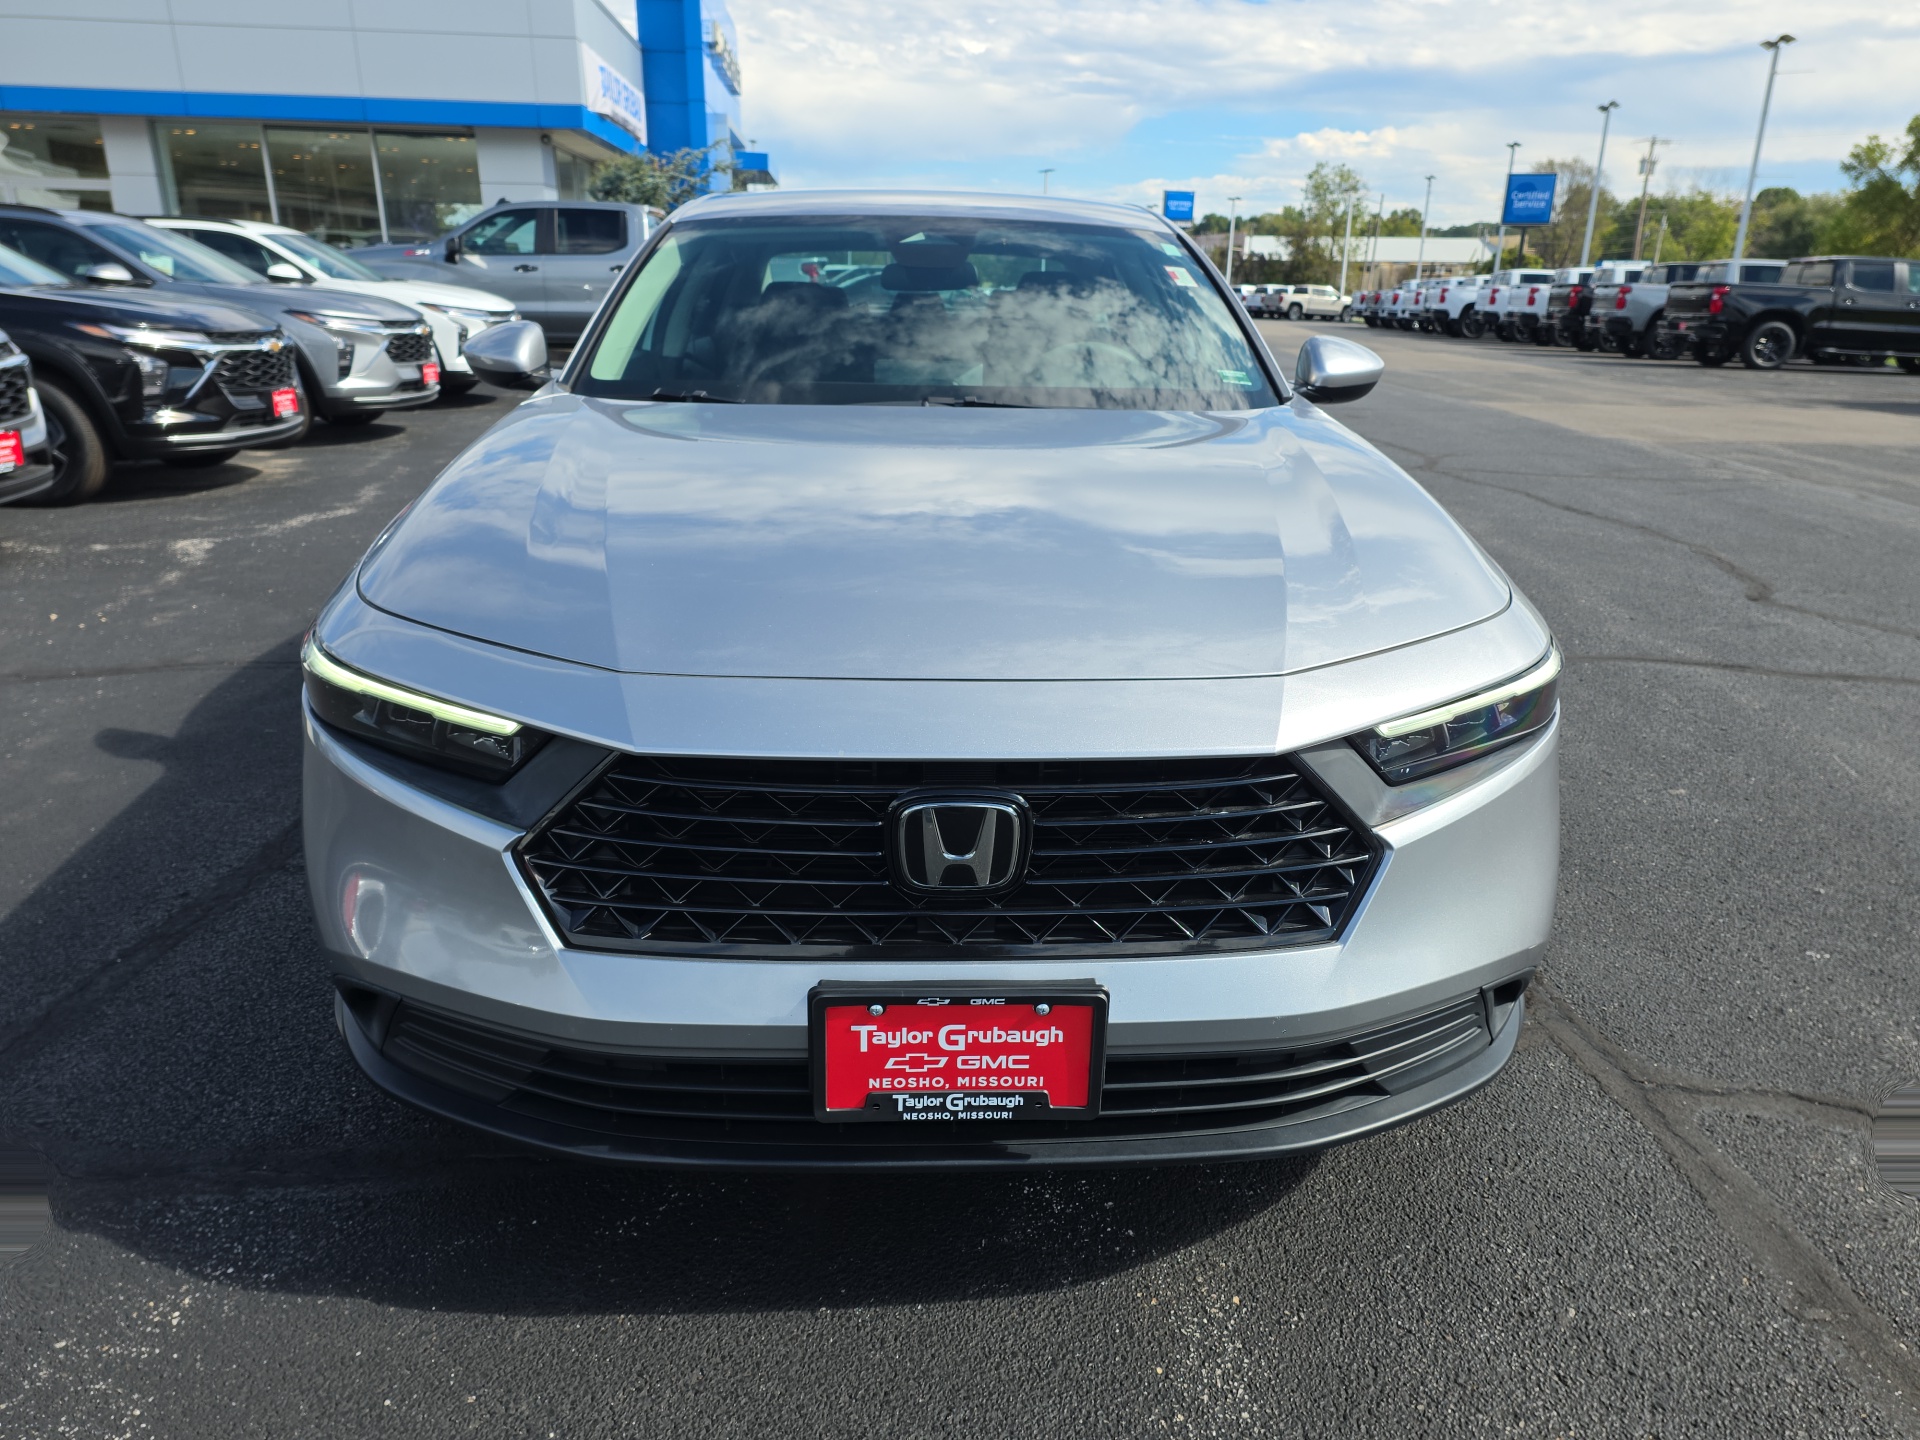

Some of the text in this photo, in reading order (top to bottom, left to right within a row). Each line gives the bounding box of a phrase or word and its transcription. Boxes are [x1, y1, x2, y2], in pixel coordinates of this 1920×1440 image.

[850, 1024, 1063, 1052] Taylor Grubaugh
[956, 1055, 1030, 1069] GMC
[868, 1076, 1044, 1089] NEOSHO, MISSOURI
[892, 1093, 1024, 1112] Taylor Grubaugh
[903, 1111, 1013, 1121] NEOSHO, MISSOURI
